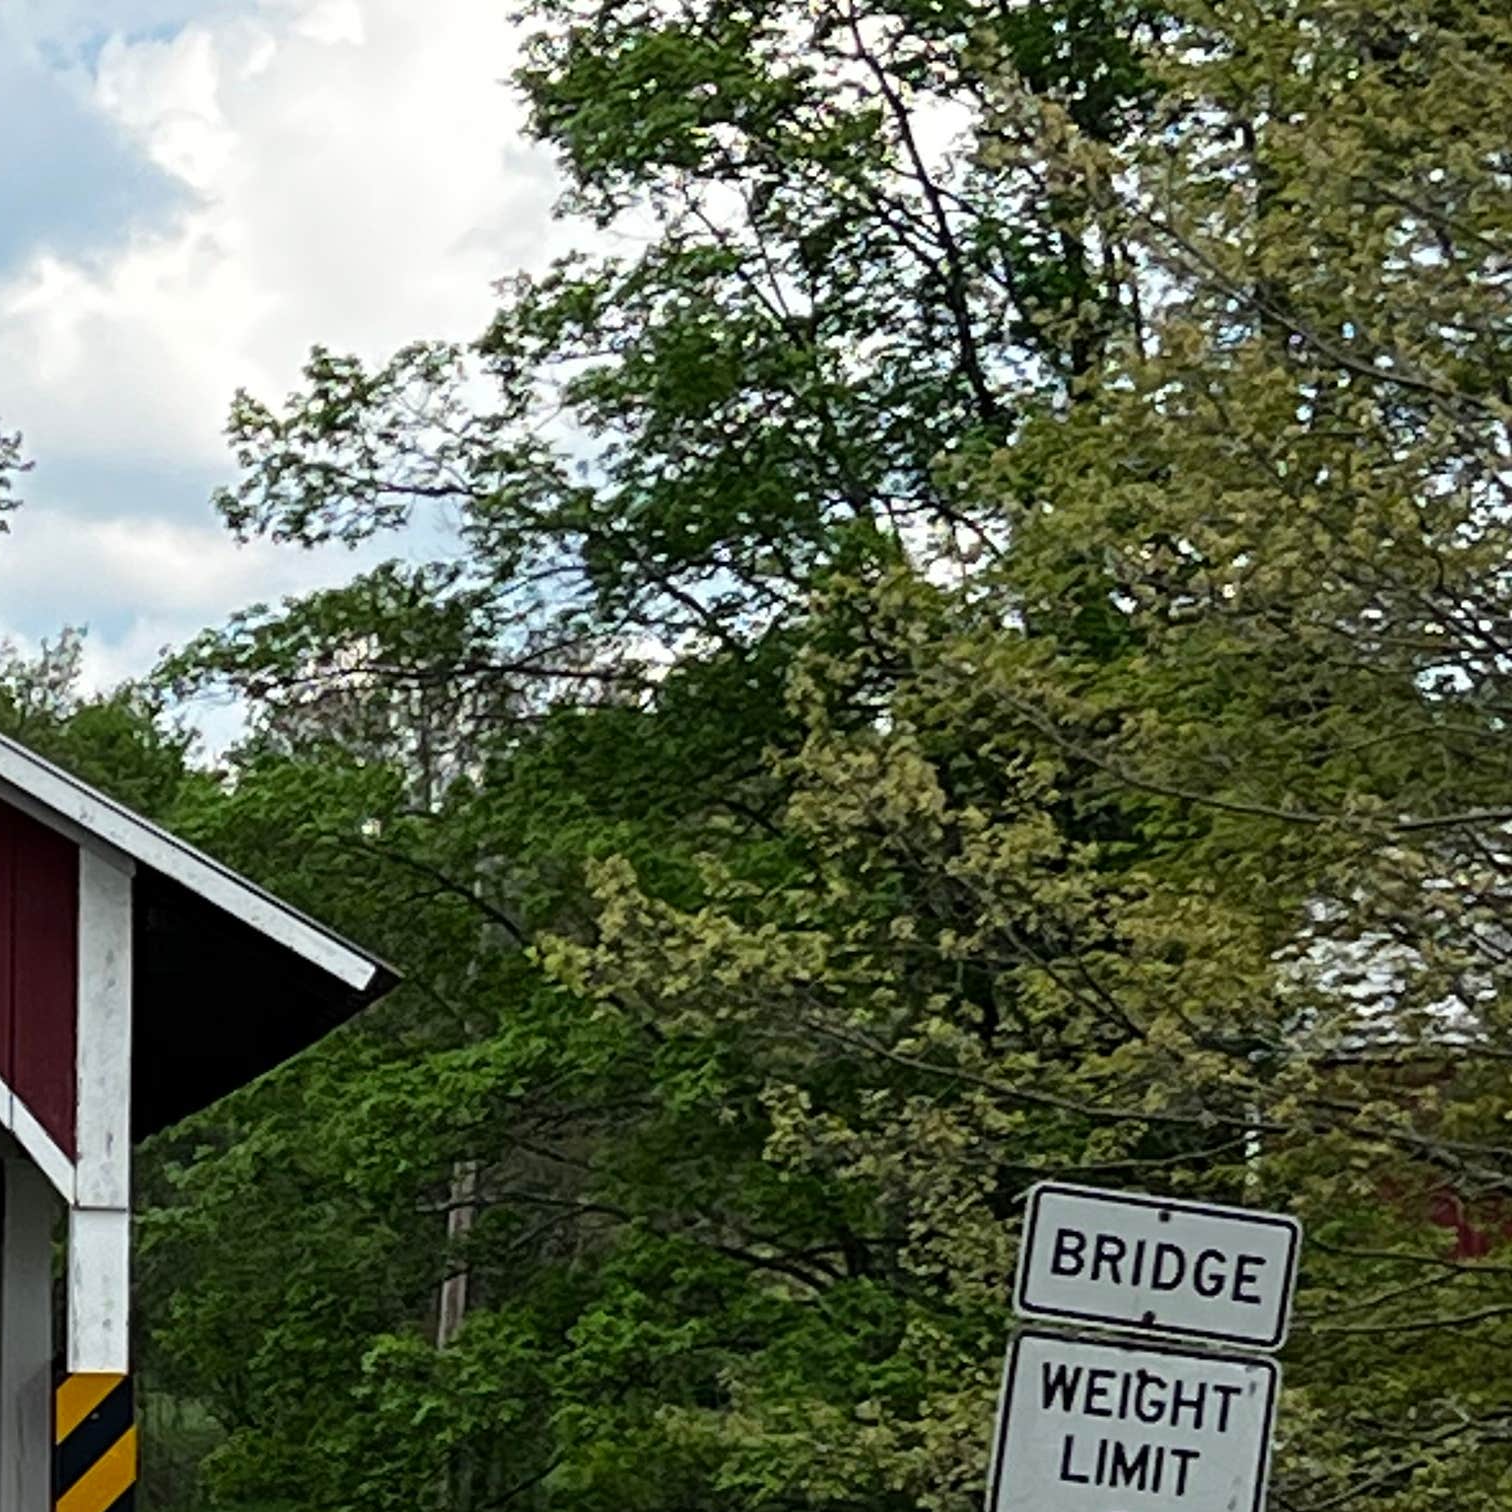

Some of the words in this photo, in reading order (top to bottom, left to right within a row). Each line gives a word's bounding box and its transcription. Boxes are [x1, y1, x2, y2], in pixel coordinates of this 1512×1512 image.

[1050, 1228, 1267, 1305] BRIDGE
[1041, 1361, 1242, 1433] WEIGHT
[1059, 1434, 1201, 1497] LIMIT
